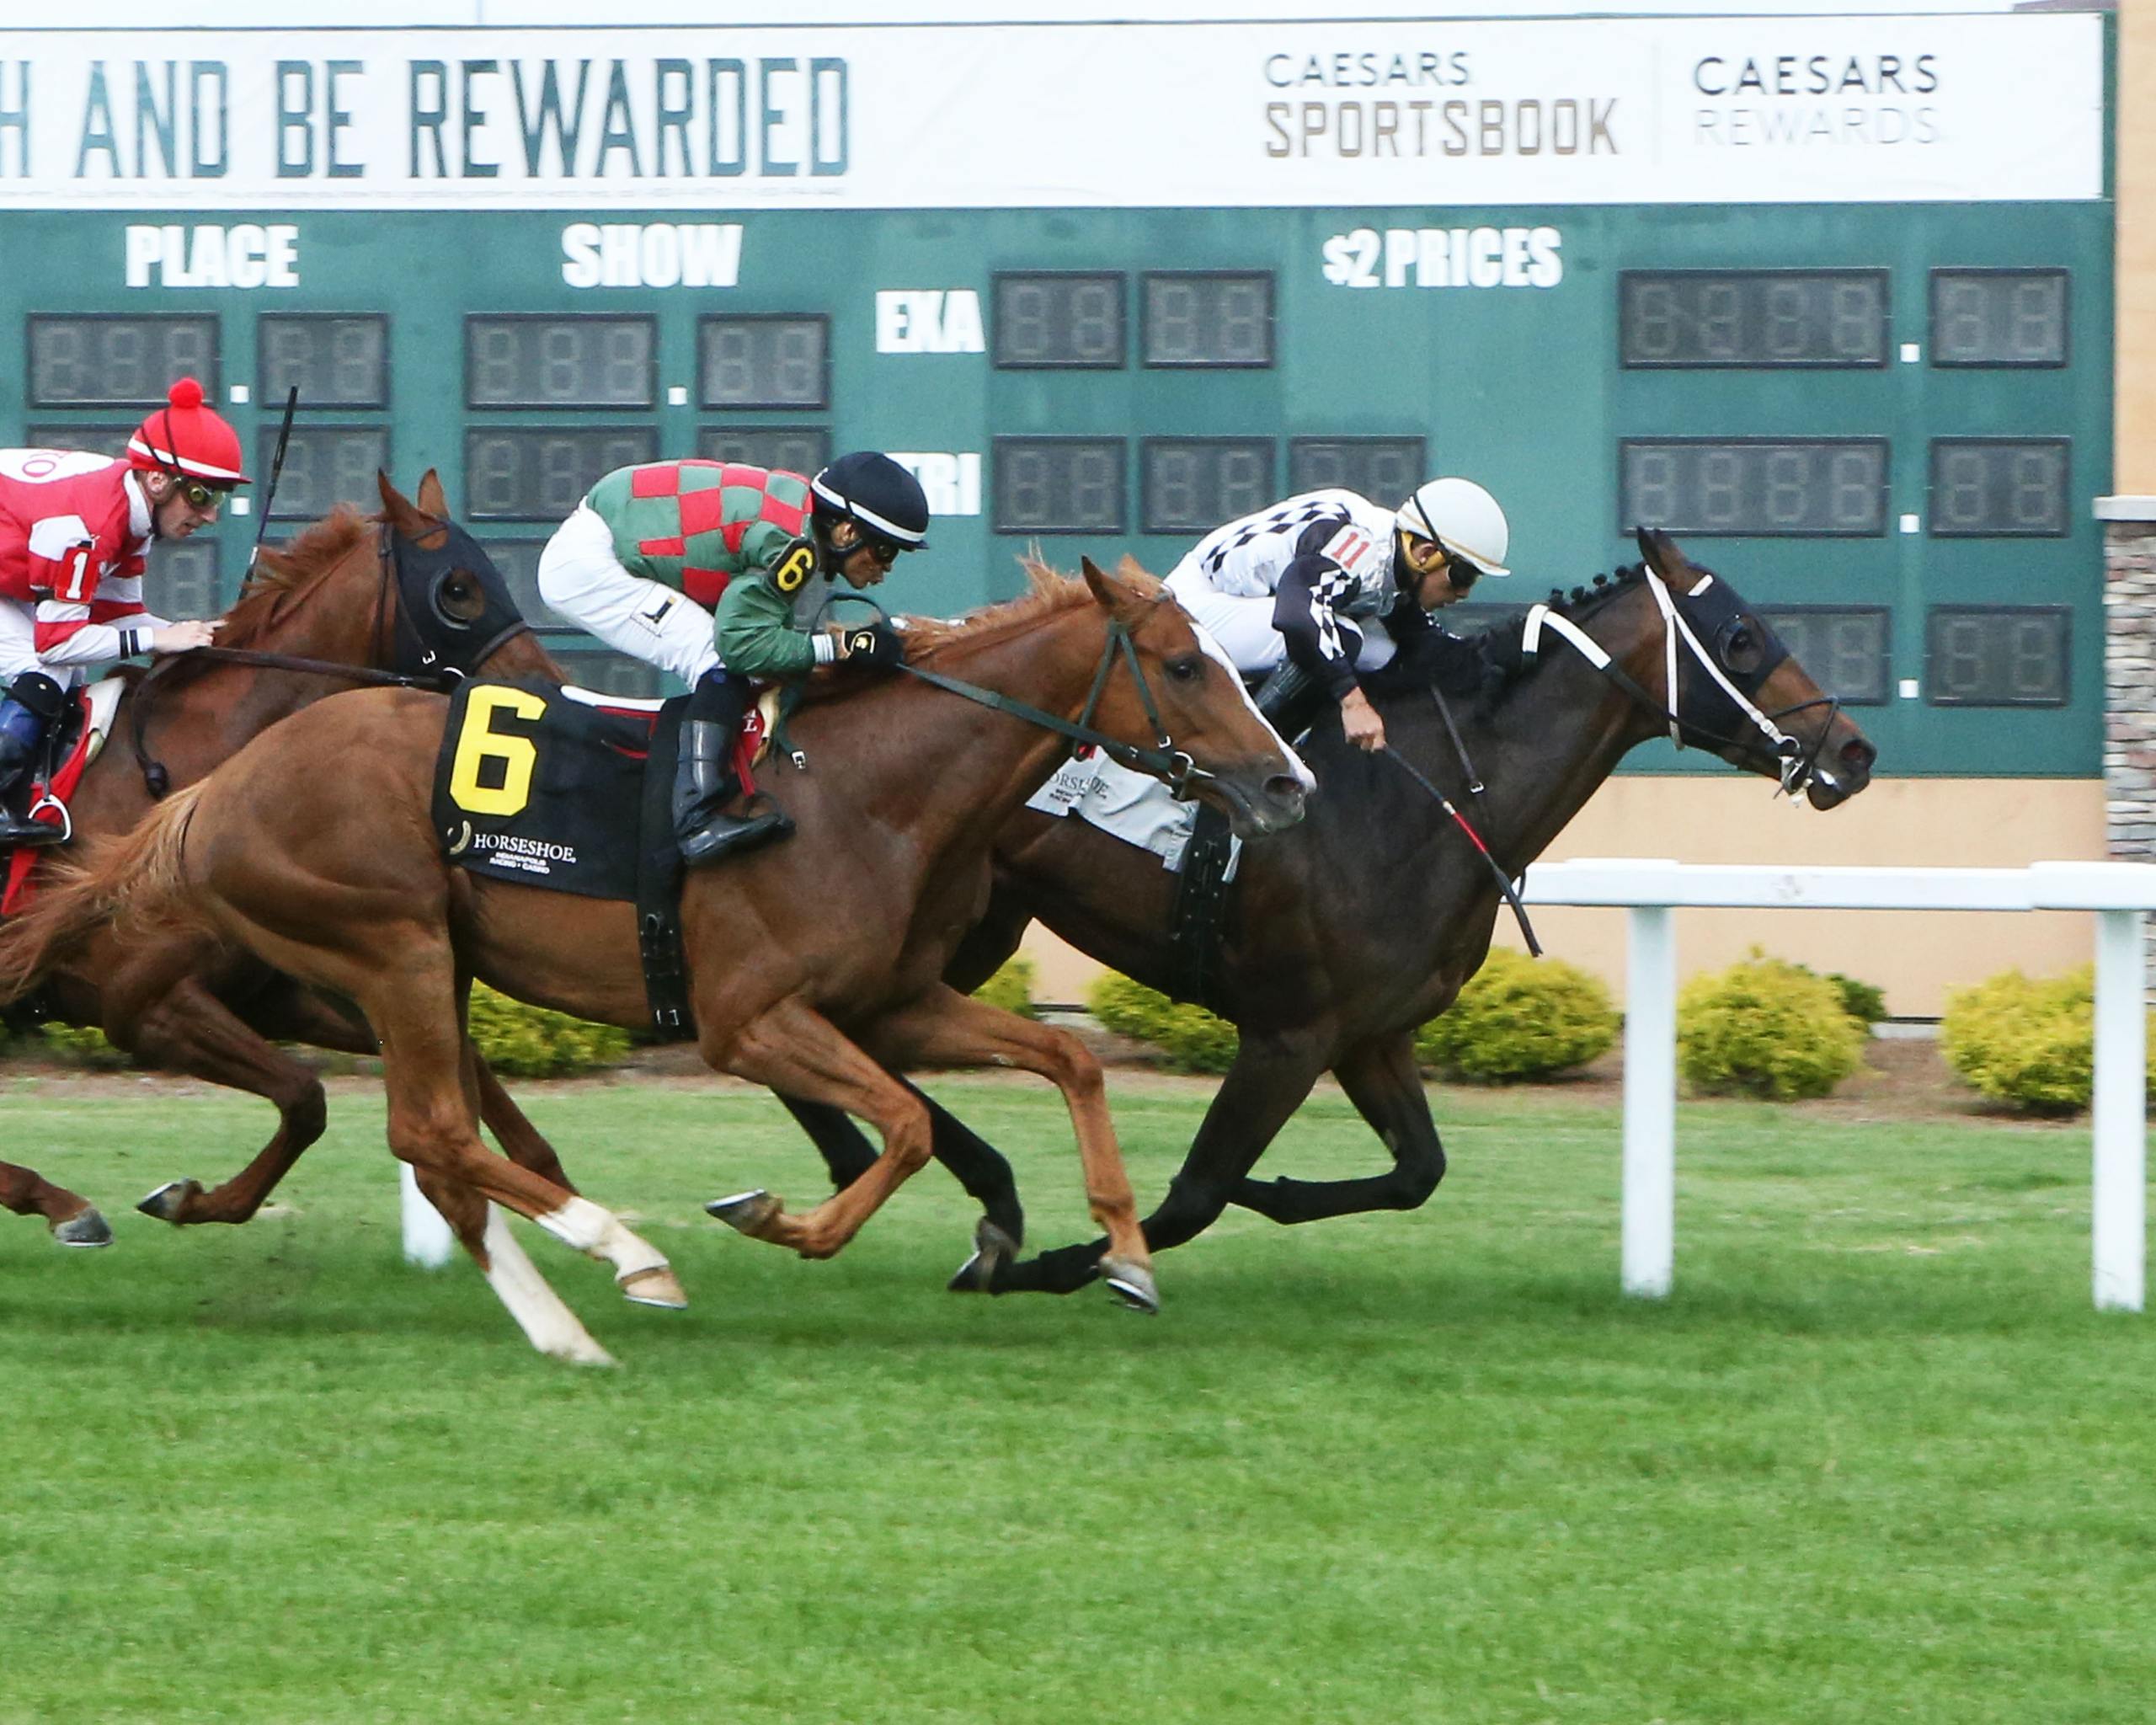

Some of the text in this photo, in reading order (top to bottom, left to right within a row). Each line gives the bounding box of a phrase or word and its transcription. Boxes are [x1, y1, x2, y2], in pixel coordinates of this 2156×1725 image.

[1265, 51, 1471, 88] CAESARS
[1694, 54, 1939, 96] CAESARS
[71, 60, 228, 178] AND
[275, 59, 366, 178] BE
[408, 57, 847, 178] REWARDED
[1265, 98, 1620, 158] SPORTSBOOK
[1694, 107, 1939, 146] REWARDS
[125, 223, 299, 288] PLACE
[561, 222, 744, 288] SHOW
[1321, 227, 1563, 288] $2 PRICES
[875, 289, 986, 354] EXA
[66, 552, 89, 599] 1
[776, 547, 814, 592] 6
[1331, 531, 1370, 570] 11
[449, 684, 547, 816] 6
